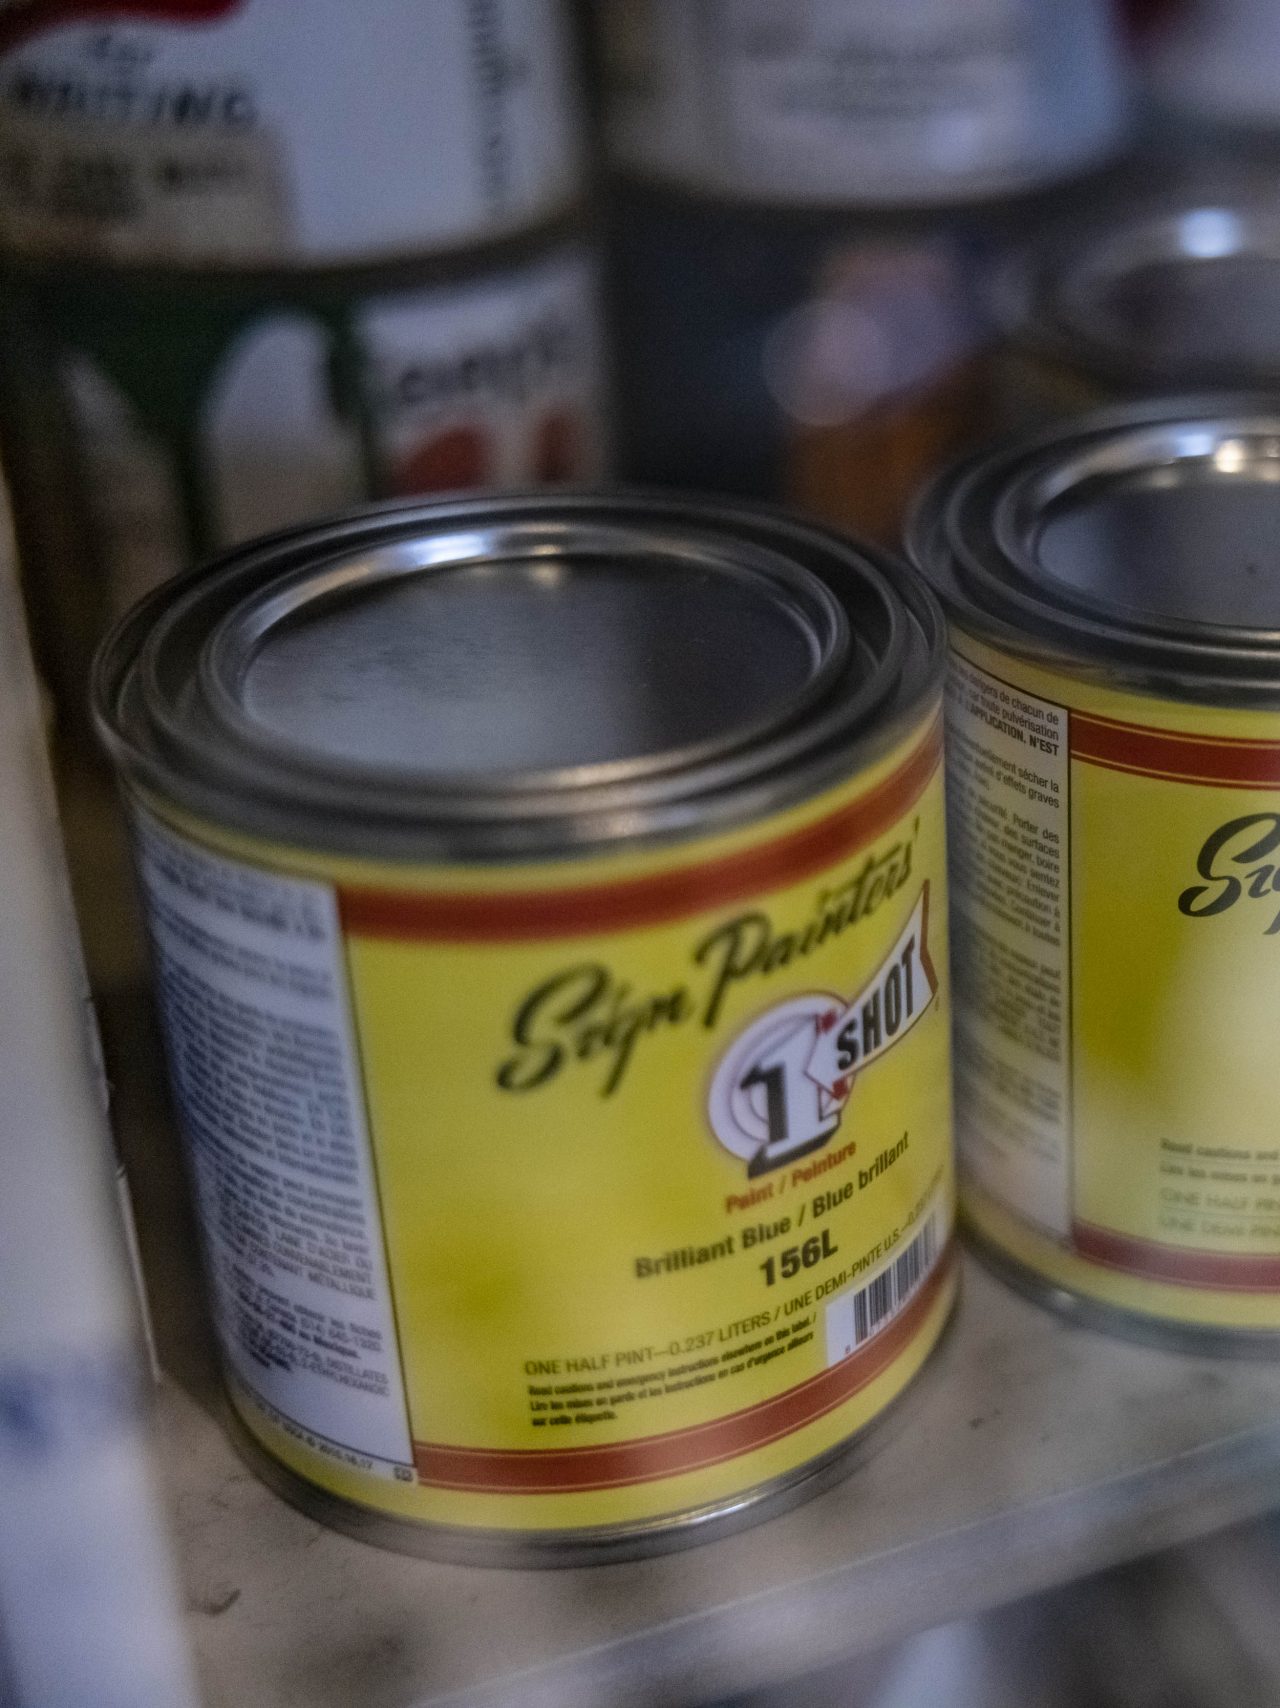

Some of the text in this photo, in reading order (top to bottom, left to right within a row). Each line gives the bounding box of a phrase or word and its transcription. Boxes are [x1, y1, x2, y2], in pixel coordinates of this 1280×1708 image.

[1002, 707, 1059, 741] pulvérisation
[1011, 697, 1044, 720] chacun
[1046, 711, 1059, 725] de
[1029, 734, 1060, 757] N'EST
[497, 962, 690, 1098] Sign
[834, 936, 918, 1071] SHOT
[634, 1233, 736, 1280] Brilliant
[741, 1215, 792, 1251] Blue
[811, 1181, 854, 1218] Blue
[857, 1130, 910, 1190] brillant
[723, 1181, 775, 1215] Paint
[790, 1140, 857, 1189] Peinture
[759, 1227, 839, 1288] 156L
[524, 1360, 561, 1375] ONE
[566, 1354, 609, 1373] HALF
[718, 1310, 772, 1343] LITERS
[783, 1292, 813, 1316] UNE
